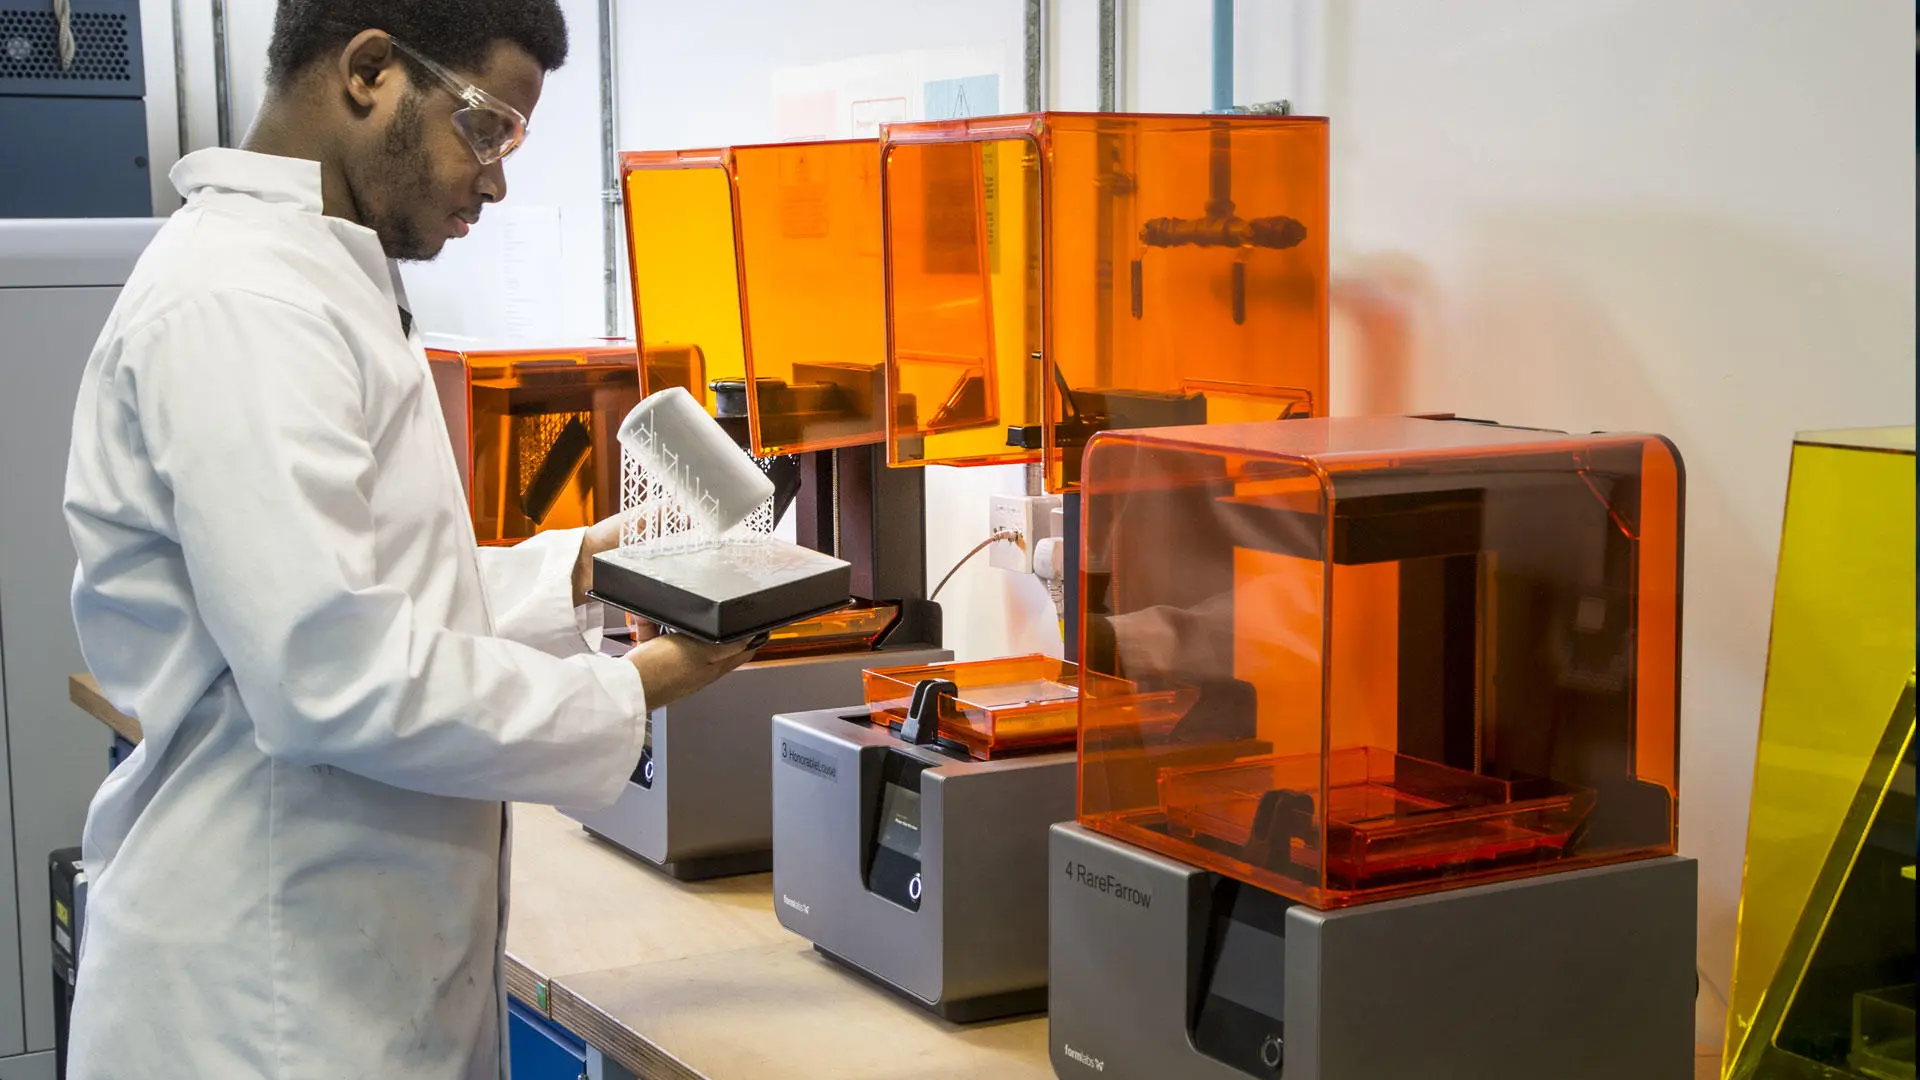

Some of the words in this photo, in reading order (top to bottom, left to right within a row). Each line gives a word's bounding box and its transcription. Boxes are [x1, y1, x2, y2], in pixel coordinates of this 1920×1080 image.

[782, 741, 788, 759] 3
[1065, 860, 1073, 881] 4
[1077, 863, 1151, 909] RareFarrow
[1064, 1044, 1095, 1069] formlabs
